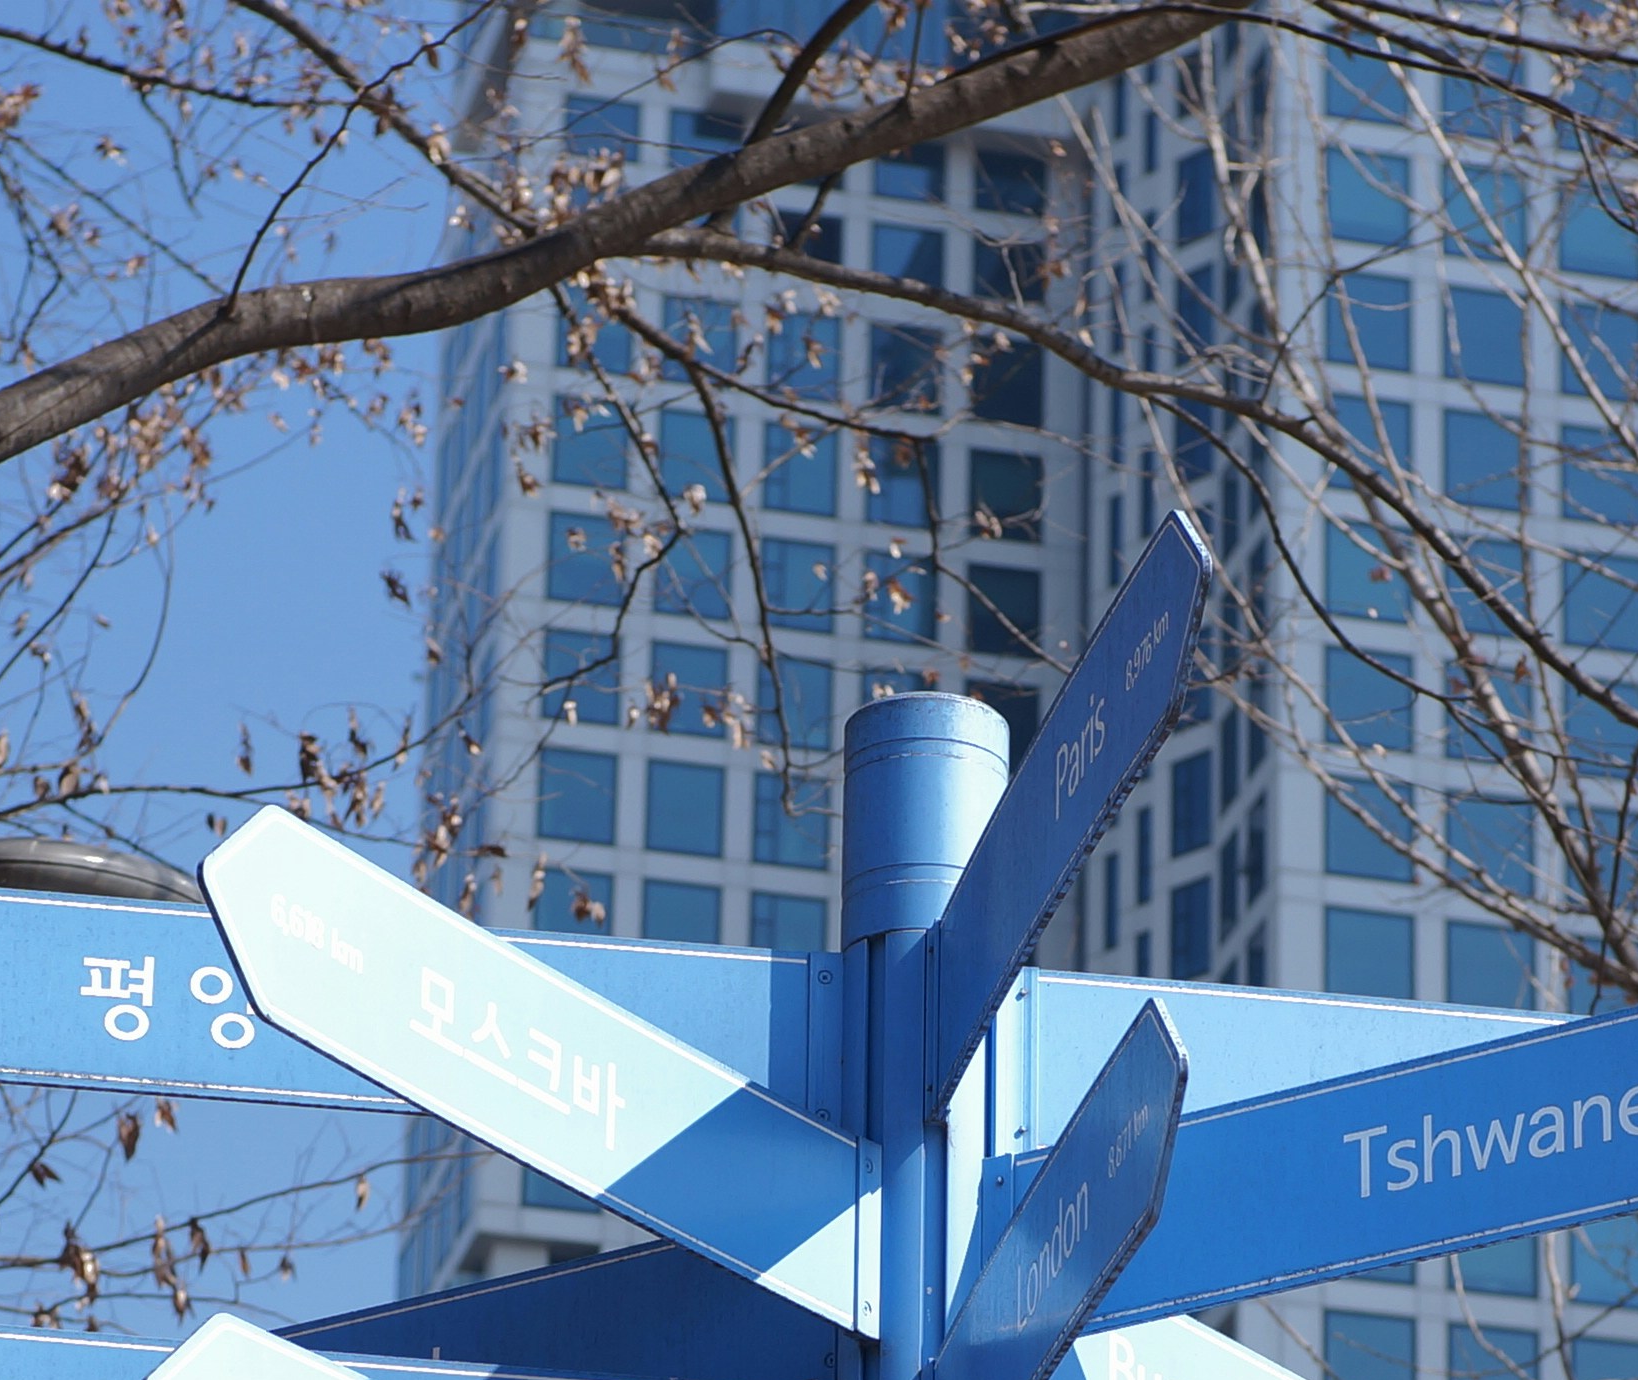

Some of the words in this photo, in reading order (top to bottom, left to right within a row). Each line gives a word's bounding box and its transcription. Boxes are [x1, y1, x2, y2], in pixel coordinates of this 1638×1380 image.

[1055, 693, 1106, 823] Paris
[1125, 631, 1152, 691] 8,976
[1153, 611, 1170, 648] km
[331, 927, 364, 975] km
[409, 967, 626, 1151] 모스크바
[1017, 1181, 1089, 1336] London
[1133, 1104, 1149, 1142] km
